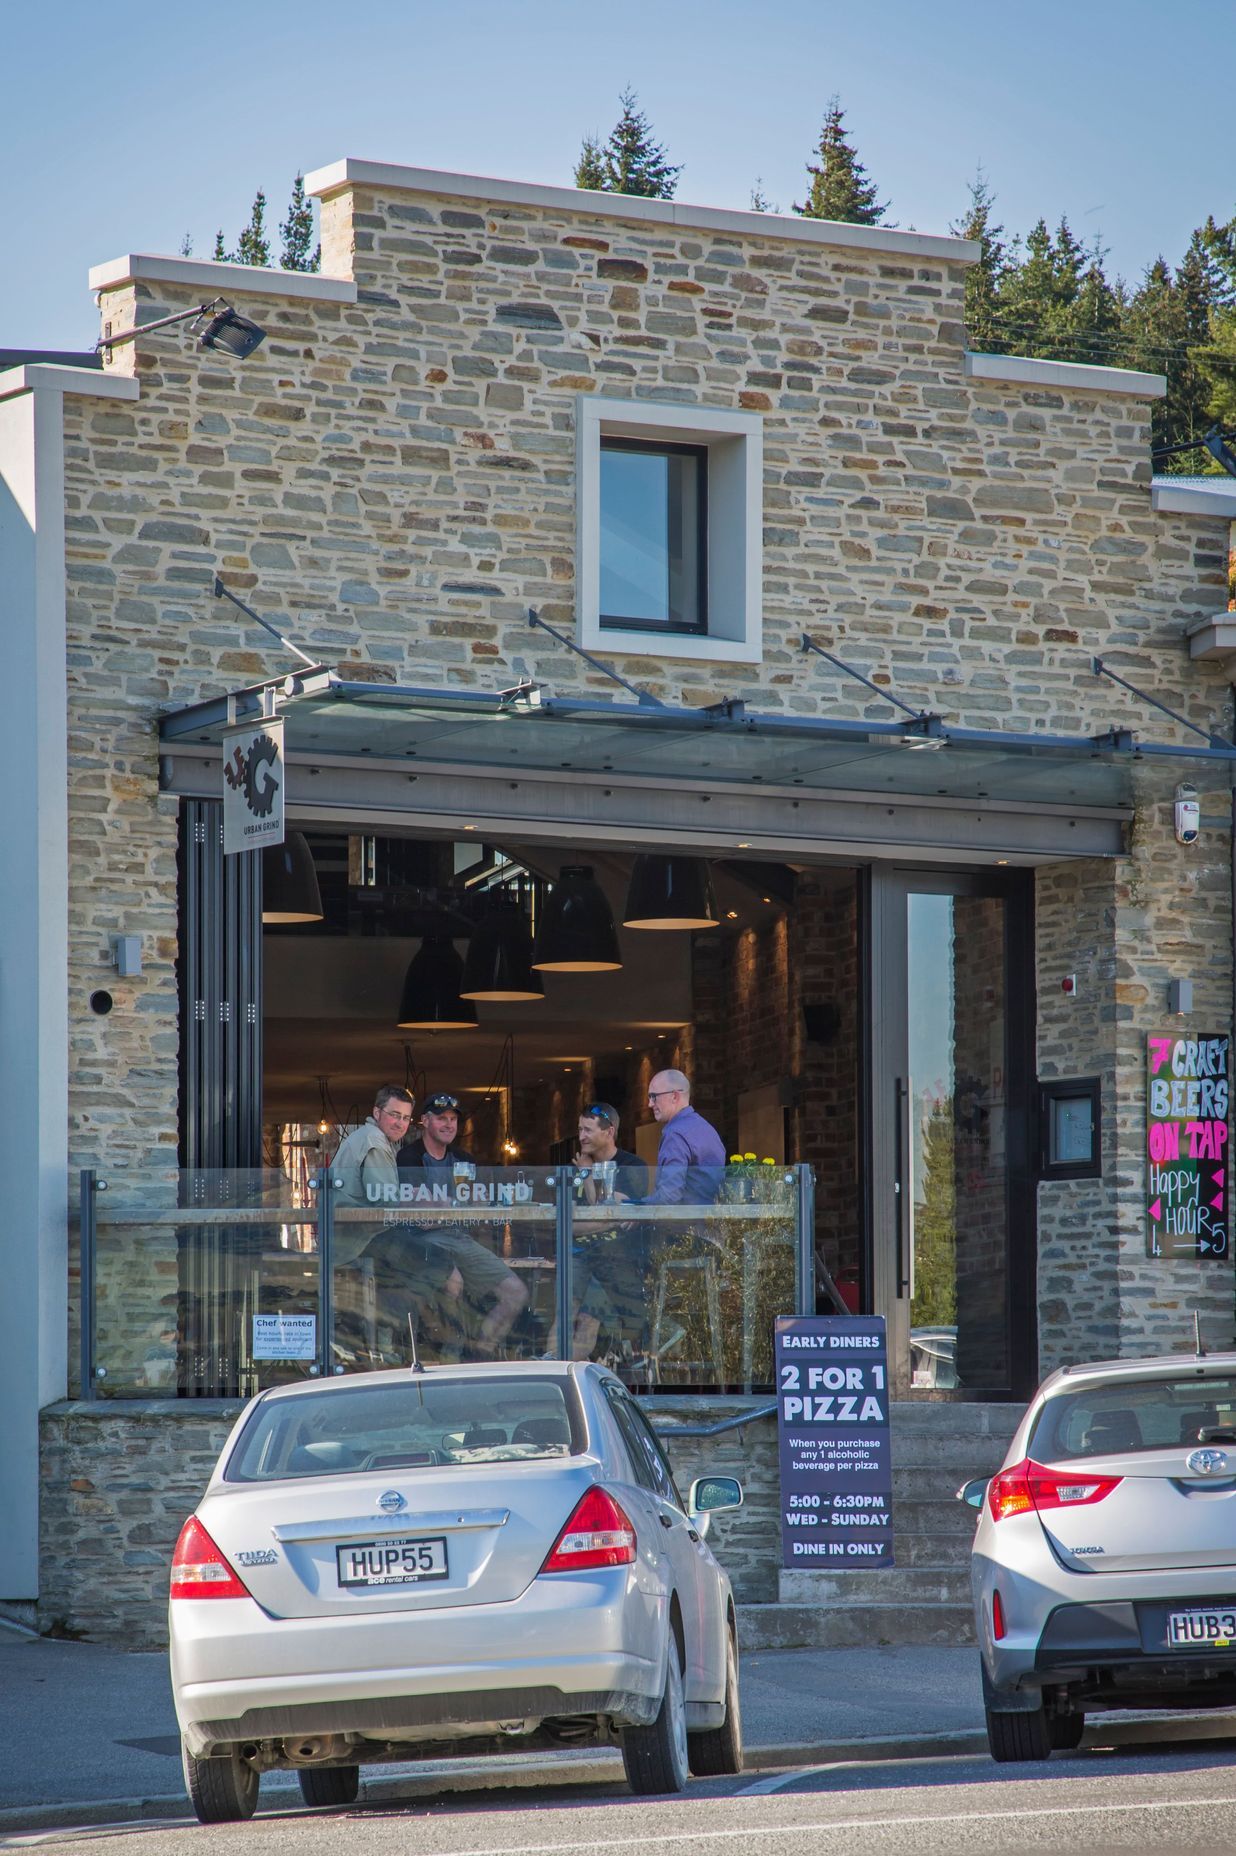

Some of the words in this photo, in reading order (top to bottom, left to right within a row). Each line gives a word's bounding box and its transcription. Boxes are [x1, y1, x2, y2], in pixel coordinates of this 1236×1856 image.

[244, 823, 261, 835] URBAN
[262, 820, 280, 832] GRIND
[1149, 1037, 1171, 1074] 7
[1172, 1039, 1229, 1077] CRAFT
[1150, 1078, 1229, 1120] BEERS
[1149, 1122, 1180, 1161] ON
[1184, 1121, 1228, 1160] TAP
[366, 1183, 448, 1201] URBAN
[456, 1183, 529, 1201] GRIND
[1150, 1163, 1200, 1207] Happy
[384, 1217, 433, 1227] ESPRESSO
[446, 1217, 481, 1227] EATERY
[493, 1216, 513, 1226] BAR
[1211, 1223, 1226, 1253] 5
[783, 1335, 826, 1348] EARLY
[830, 1335, 879, 1348] DINERS
[781, 1365, 801, 1390] 2
[808, 1367, 864, 1390] FOR
[871, 1366, 884, 1389] 1
[784, 1396, 884, 1420] PIZZA
[789, 1439, 816, 1448] When
[818, 1440, 835, 1450] you
[837, 1439, 881, 1450] purchase
[801, 1452, 817, 1460] any
[819, 1450, 825, 1458] 1
[827, 1450, 870, 1458] alcoholic
[793, 1461, 835, 1472] beverage
[837, 1463, 852, 1472] per
[855, 1461, 879, 1472] pizza
[790, 1495, 820, 1508] 5:00
[833, 1495, 884, 1508] 6:30PM
[786, 1513, 818, 1525] WED
[831, 1513, 889, 1525] SUNDAY
[793, 1543, 826, 1554] DINE
[830, 1543, 844, 1554] IN
[847, 1543, 884, 1554] ONLY
[351, 1546, 433, 1577] HUP55
[385, 1575, 404, 1584] rental
[1173, 1614, 1236, 1641] HUB3
